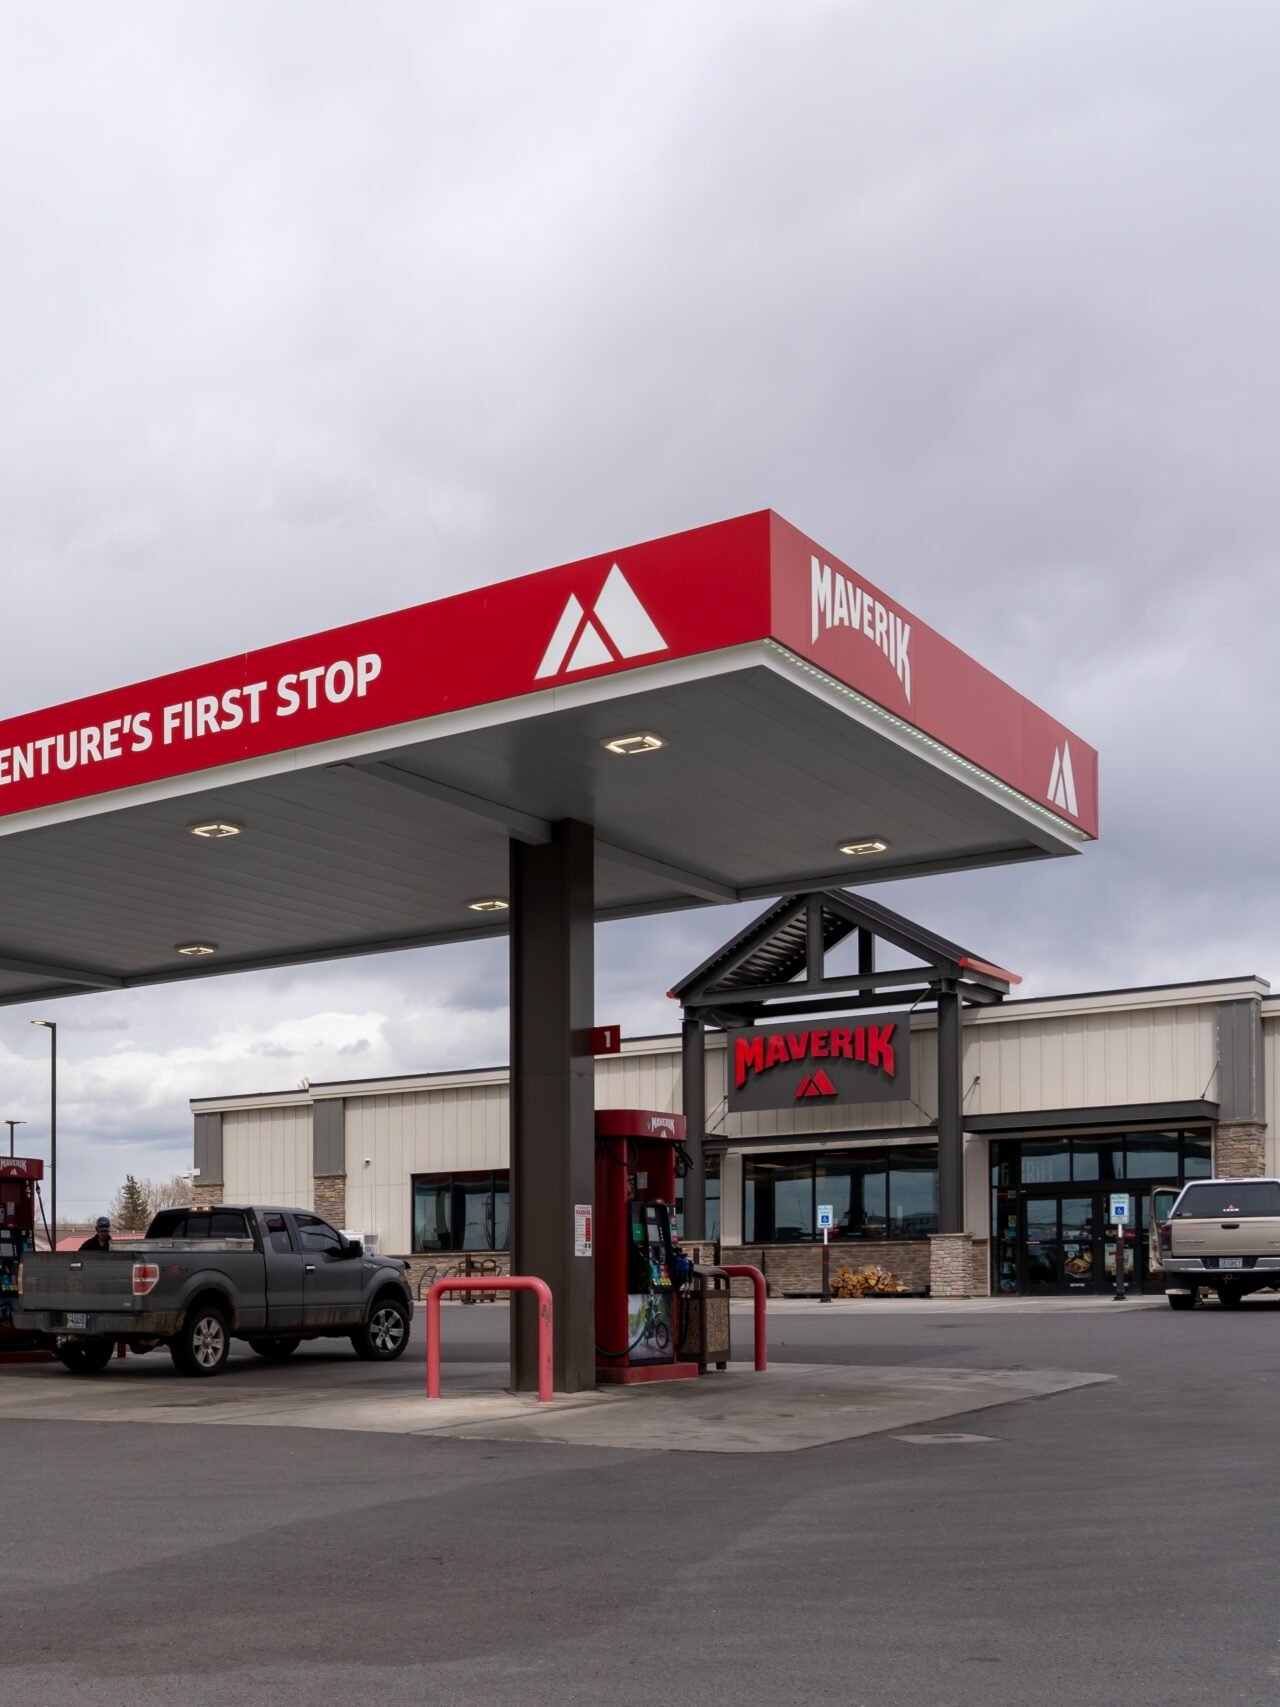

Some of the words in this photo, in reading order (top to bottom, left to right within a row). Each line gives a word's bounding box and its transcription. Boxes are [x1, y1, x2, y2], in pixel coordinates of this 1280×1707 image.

[811, 554, 911, 706] MAVERIK
[163, 681, 268, 745] FIRST
[276, 653, 382, 717] STOP
[603, 1030, 611, 1048] 1
[735, 1023, 897, 1089] MAVERIK
[651, 1117, 675, 1136] MAVERIK
